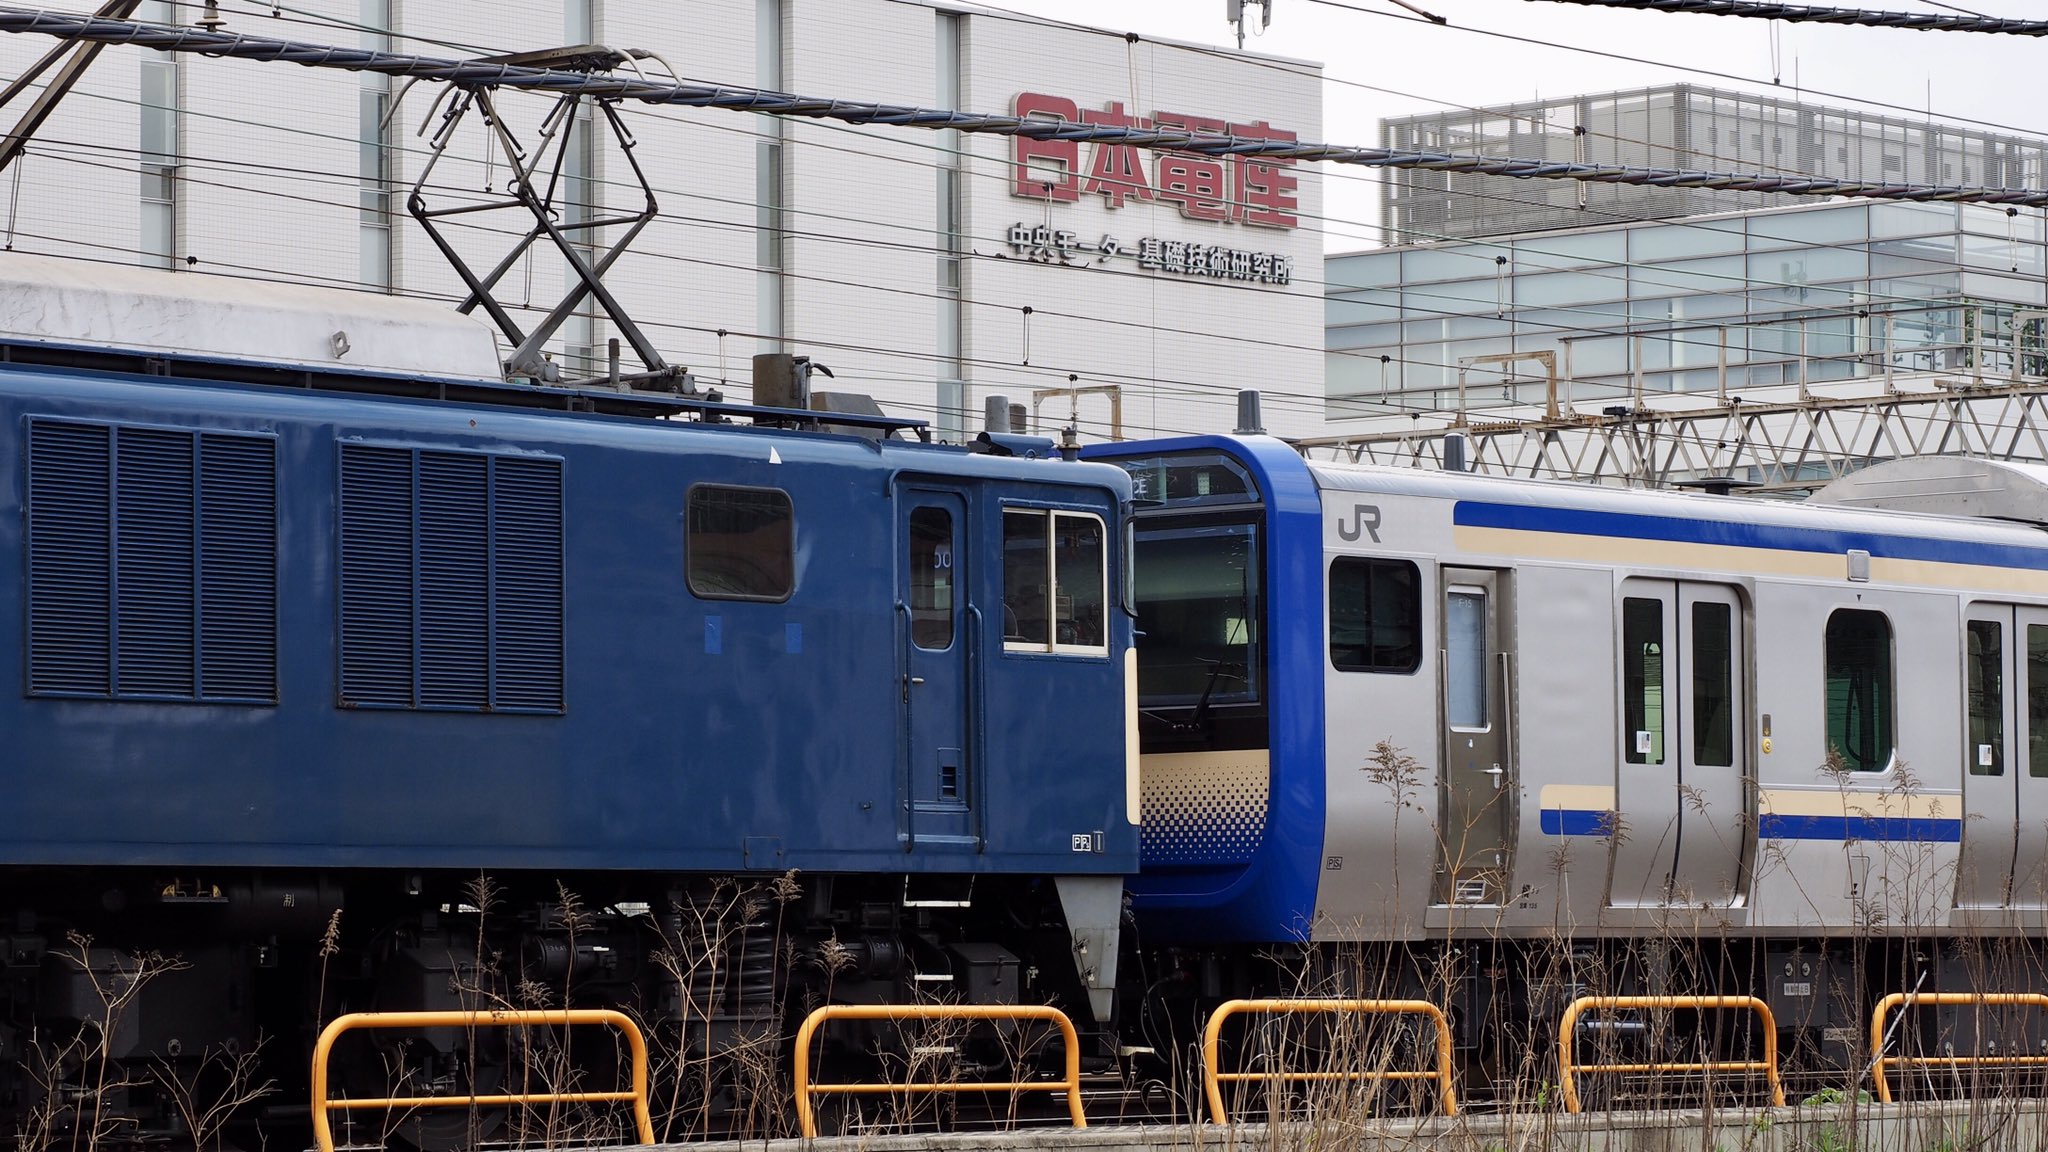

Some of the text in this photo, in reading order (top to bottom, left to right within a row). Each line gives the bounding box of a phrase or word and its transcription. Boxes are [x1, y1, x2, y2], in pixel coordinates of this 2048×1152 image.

[1008, 91, 1298, 230] 日本電産
[1008, 222, 1294, 285] 中央モーター基礎技術研究所
[1338, 504, 1381, 543] JR
